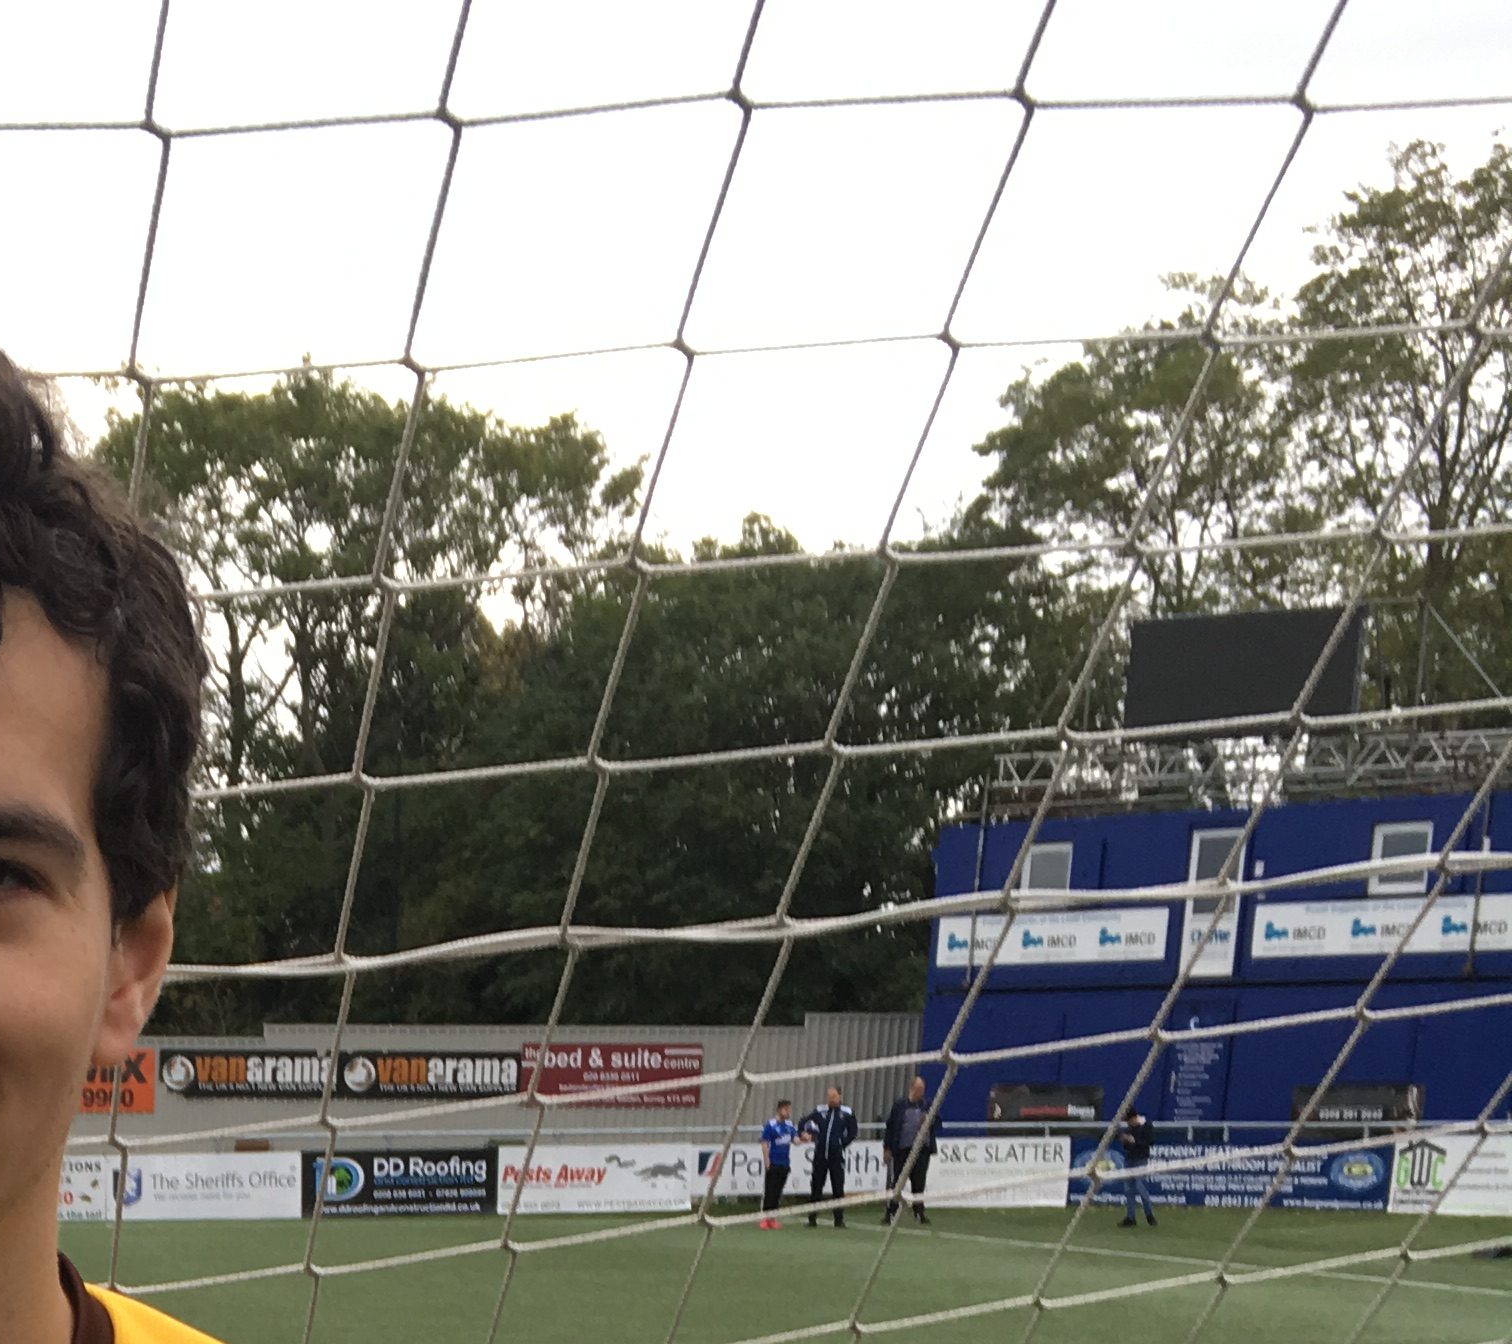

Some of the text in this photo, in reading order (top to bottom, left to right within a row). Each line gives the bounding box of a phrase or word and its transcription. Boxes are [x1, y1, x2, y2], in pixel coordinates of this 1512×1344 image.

[1124, 930, 1156, 947] IMCD
[1475, 919, 1508, 937] MCD
[1046, 934, 1077, 949] IMCD
[544, 1047, 582, 1069] bed
[588, 1046, 604, 1069] &
[610, 1047, 662, 1069] suite
[663, 1057, 700, 1070] centre
[376, 1056, 518, 1085] vanarama
[81, 1087, 134, 1108] 990
[939, 1142, 1065, 1164] S&C SLATTER
[62, 1160, 102, 1174] IONS
[373, 1154, 487, 1183] DD Roofing
[554, 1163, 608, 1186] Away
[150, 1170, 296, 1191] The Sheriffs Office
